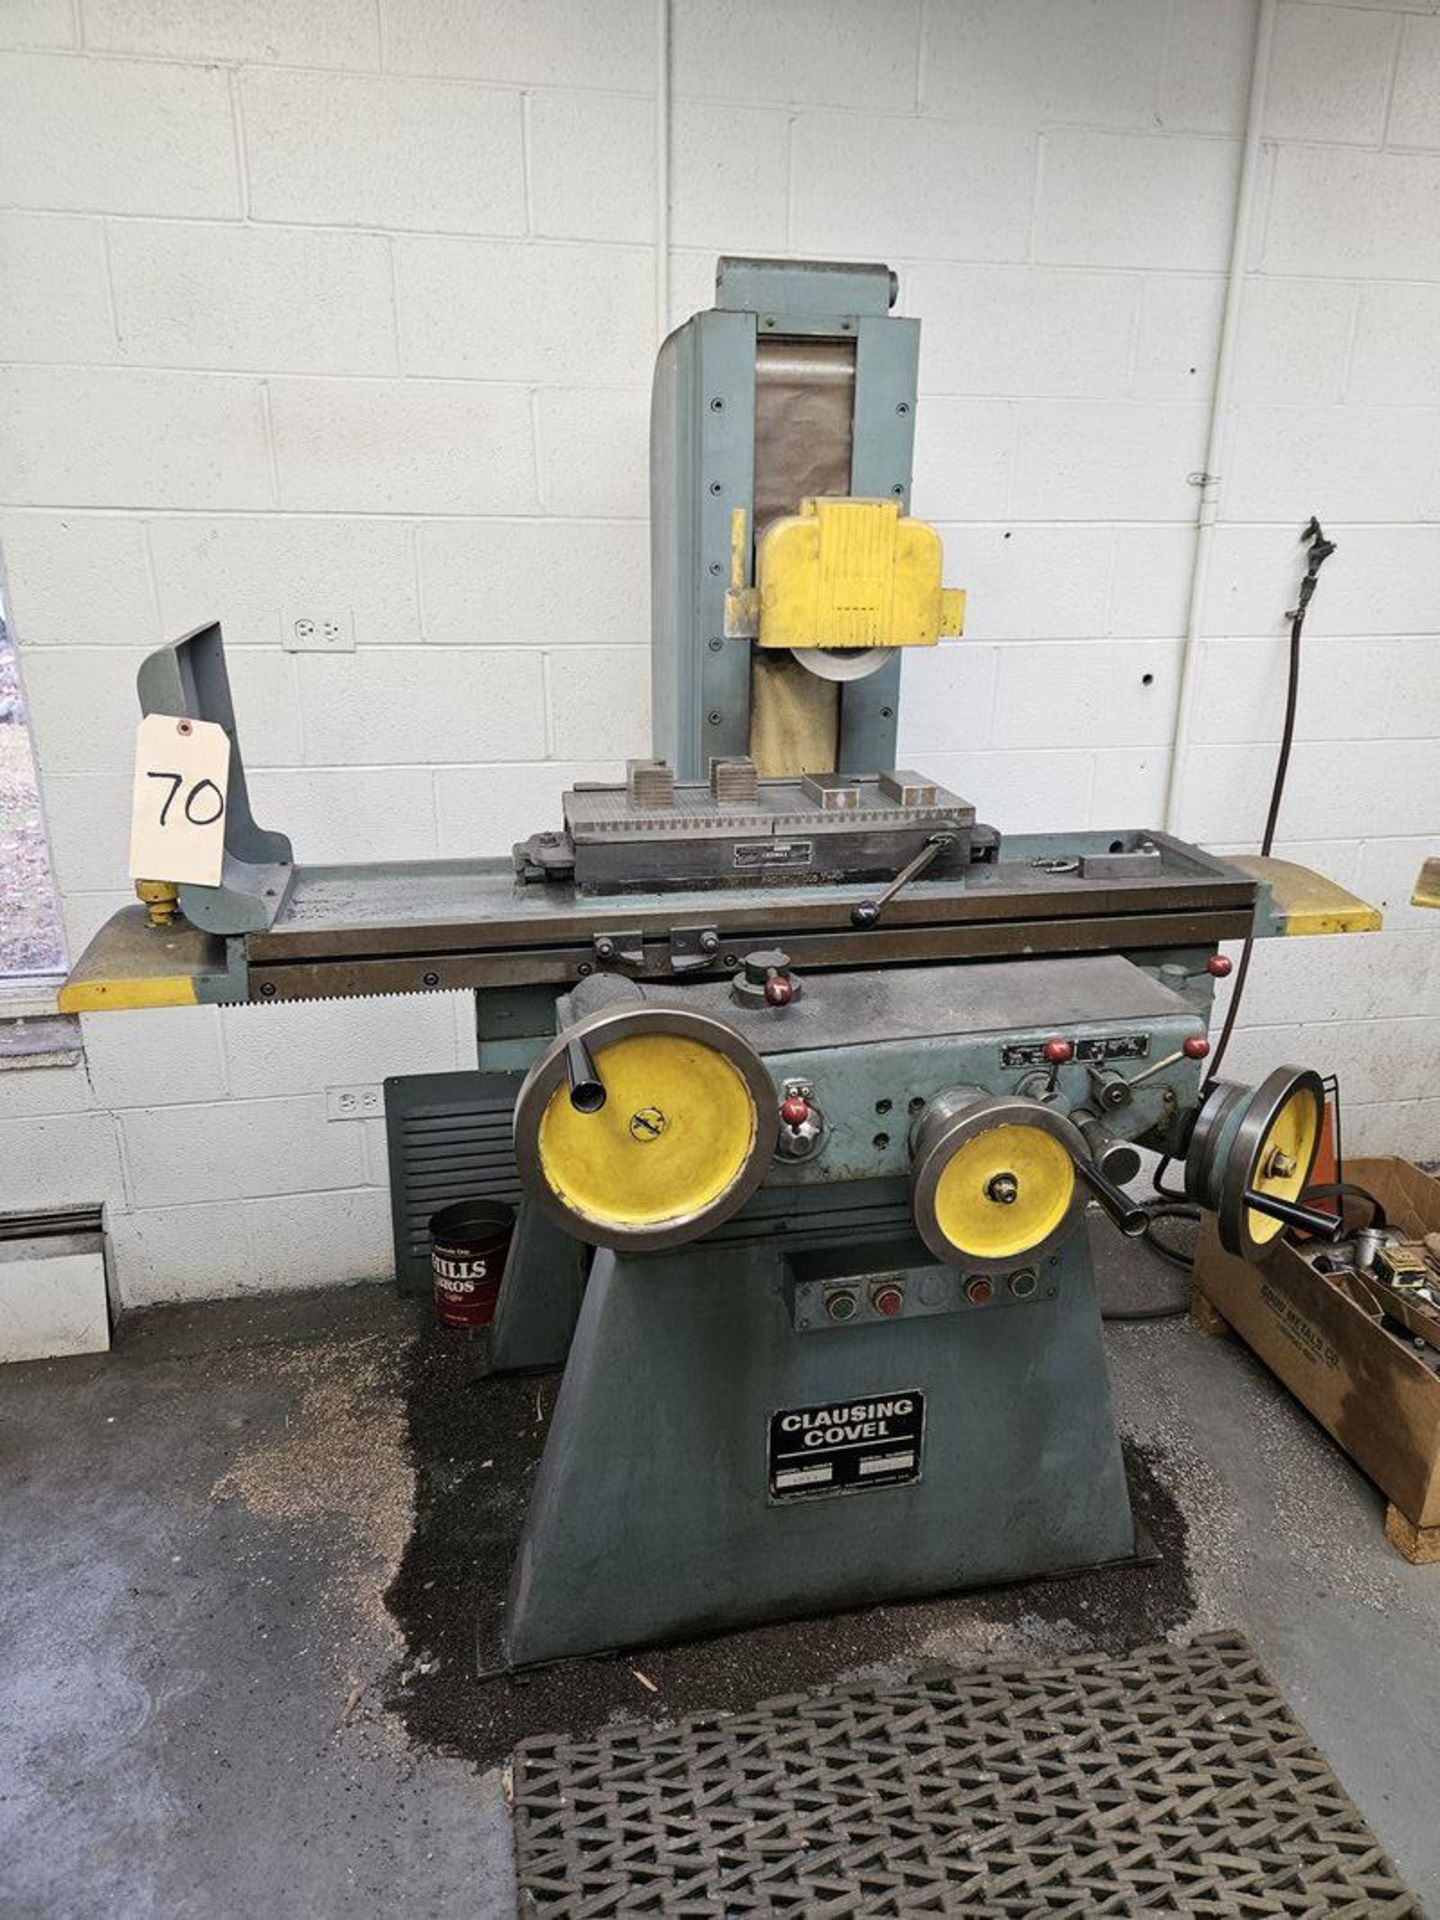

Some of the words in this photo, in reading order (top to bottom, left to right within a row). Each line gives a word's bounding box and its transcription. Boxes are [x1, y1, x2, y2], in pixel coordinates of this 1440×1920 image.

[147, 772, 224, 826] 70
[781, 1400, 913, 1431] CLAUSING
[804, 1421, 889, 1446] COVEL
